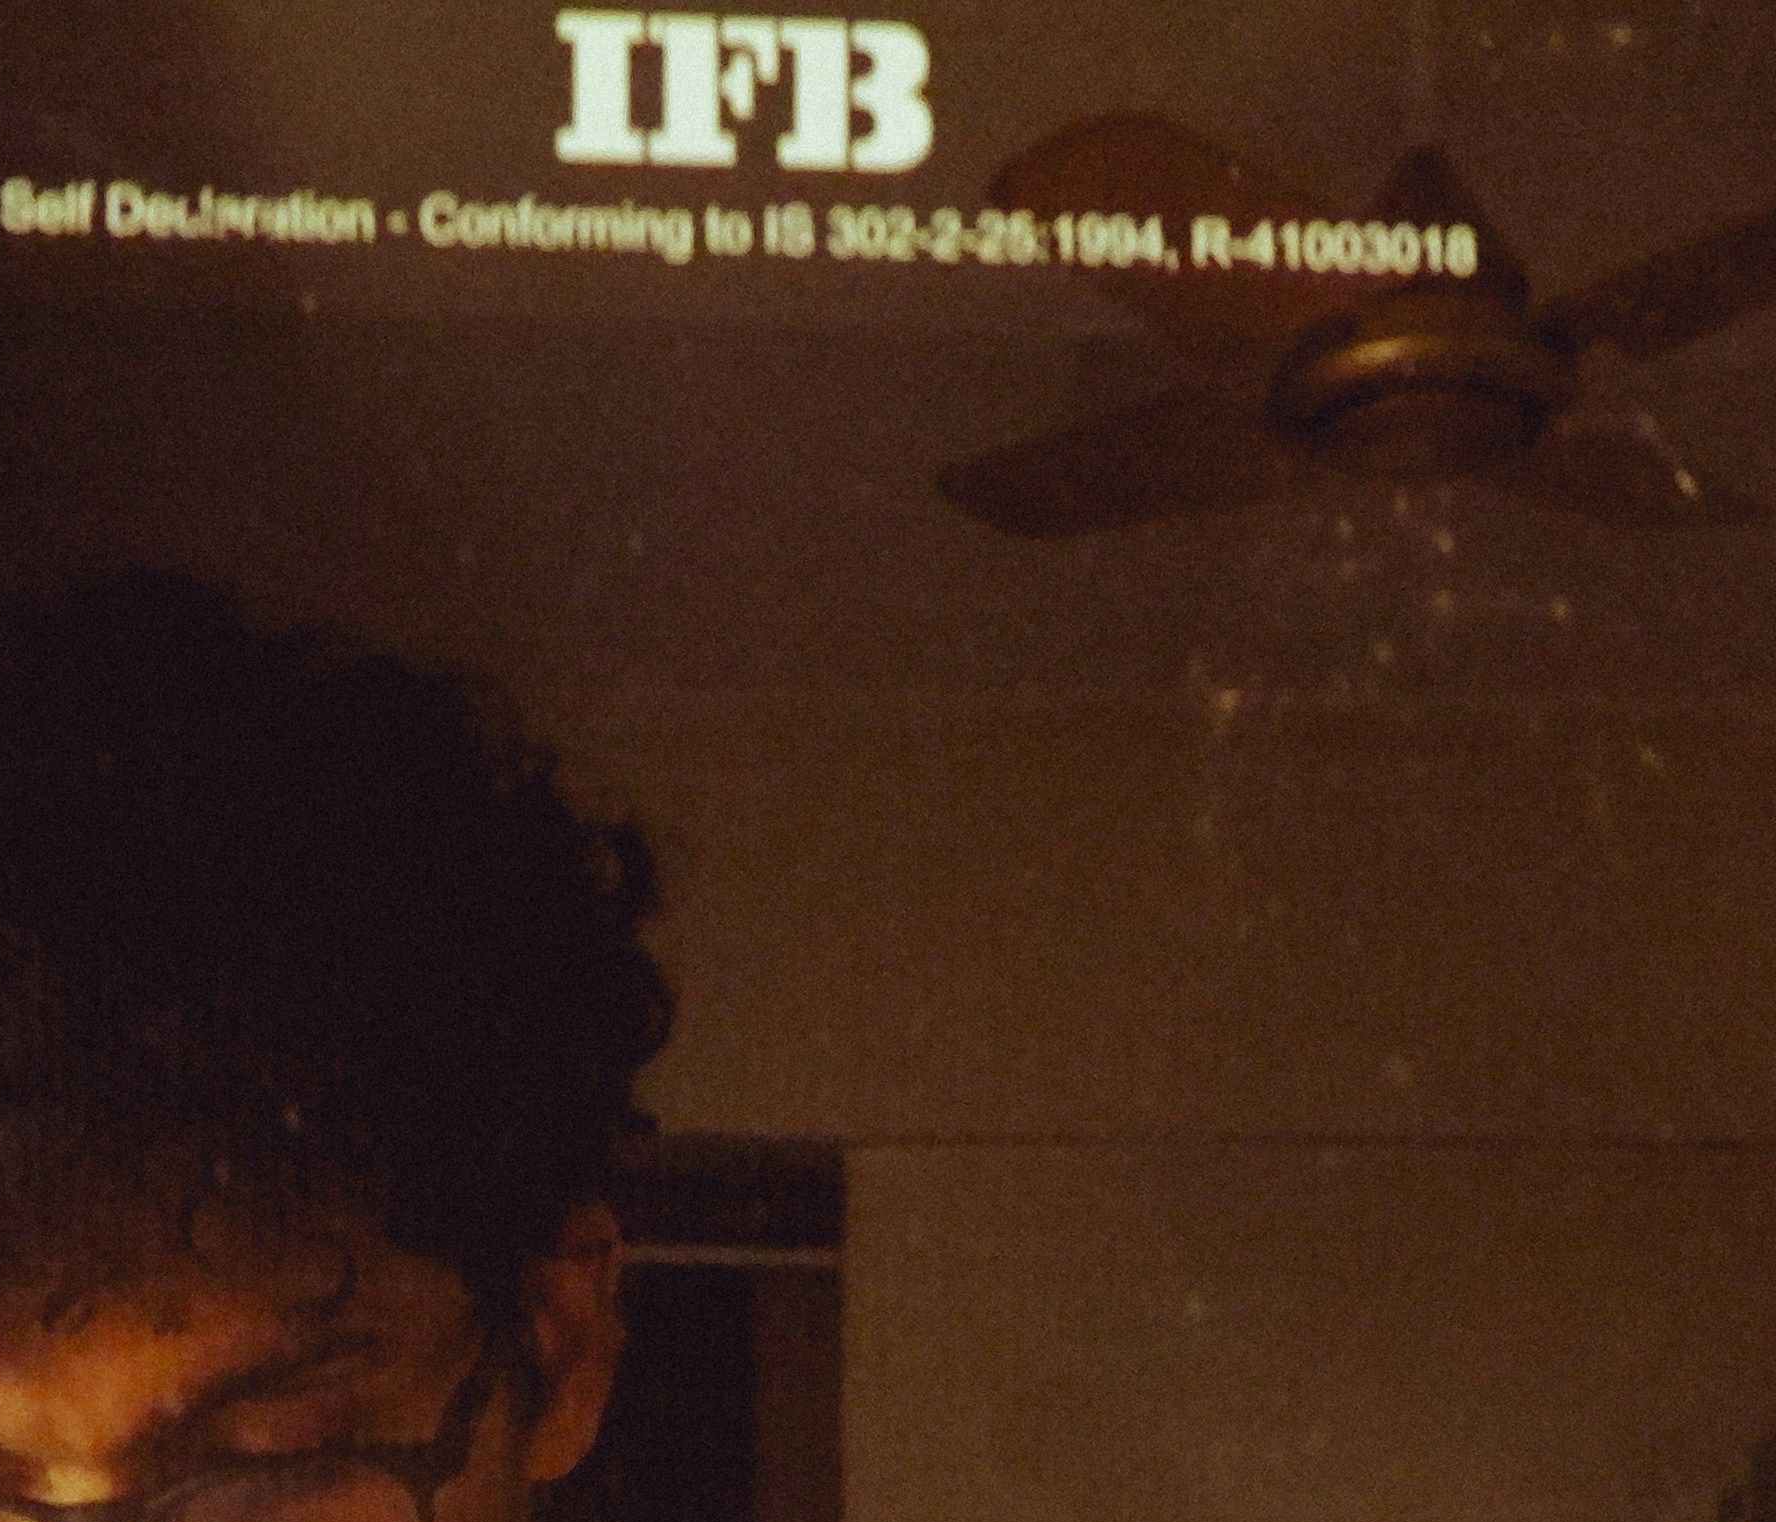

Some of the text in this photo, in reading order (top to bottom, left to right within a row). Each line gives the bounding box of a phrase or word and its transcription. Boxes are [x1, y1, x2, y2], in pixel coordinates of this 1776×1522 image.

[555, 9, 934, 174] IFB
[0, 178, 94, 236] Self
[419, 191, 695, 264] Conforming
[705, 206, 750, 255] to
[764, 202, 814, 257] IS
[1190, 217, 1479, 275] R-41003018
